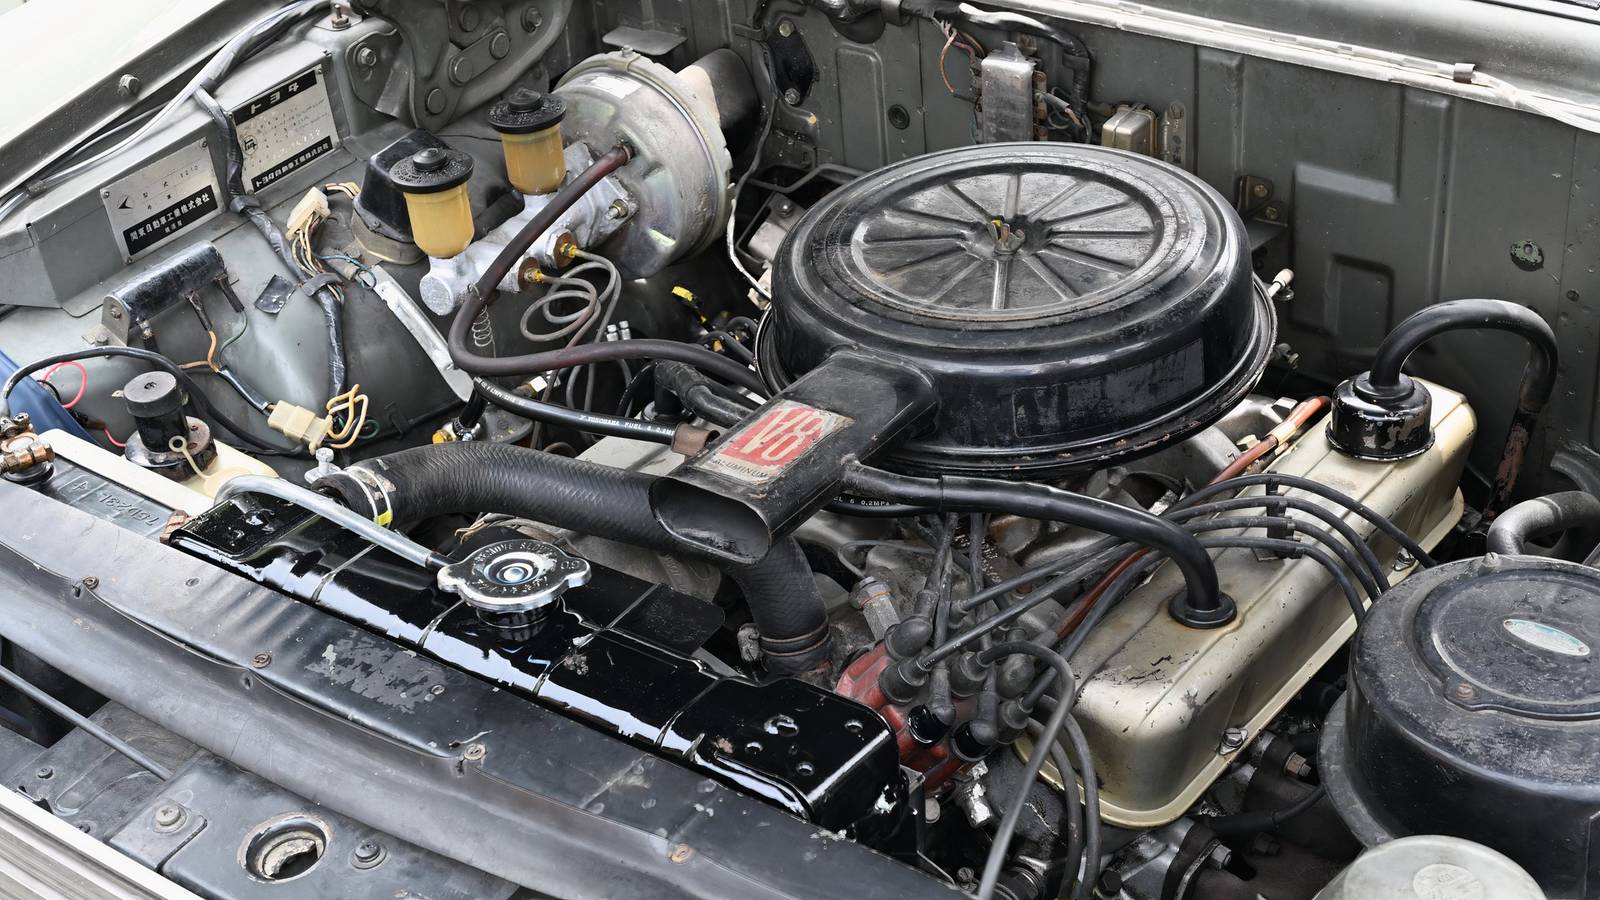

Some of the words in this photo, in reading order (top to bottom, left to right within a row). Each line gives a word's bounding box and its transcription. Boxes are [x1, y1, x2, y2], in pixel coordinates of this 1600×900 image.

[250, 82, 300, 115] トヨタ
[740, 407, 825, 461] V8
[711, 458, 769, 478] ALUMINUM
